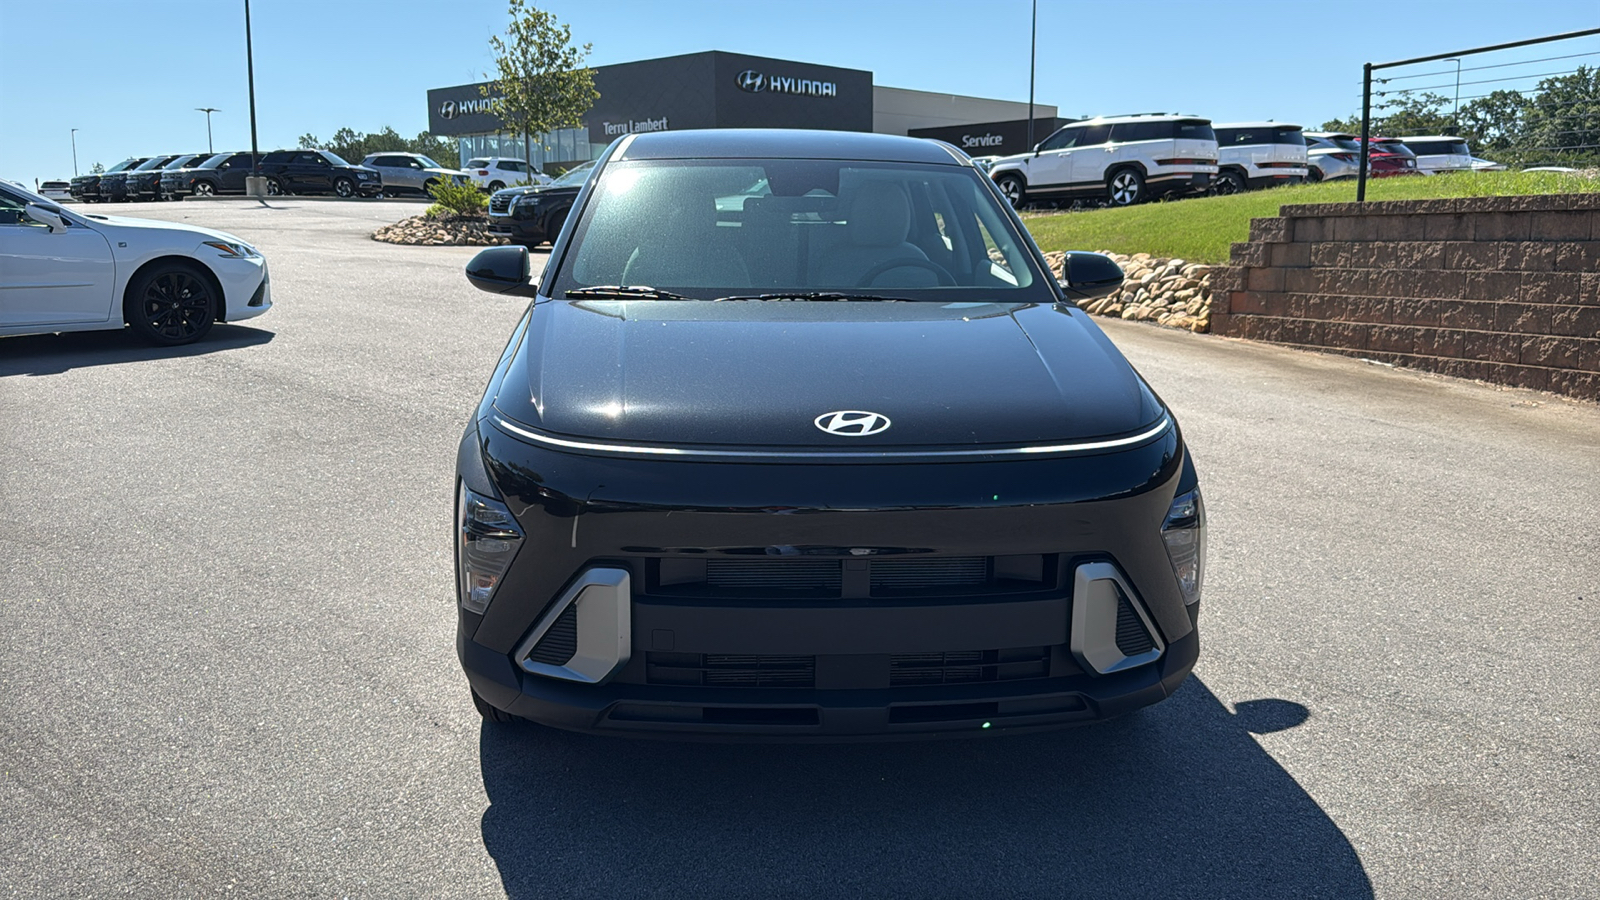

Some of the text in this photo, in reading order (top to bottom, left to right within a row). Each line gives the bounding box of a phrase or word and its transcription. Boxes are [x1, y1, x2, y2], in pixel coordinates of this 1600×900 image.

[770, 75, 837, 97] HYUNDAI
[602, 116, 668, 135] Terry Lambert
[961, 132, 1003, 148] Service
